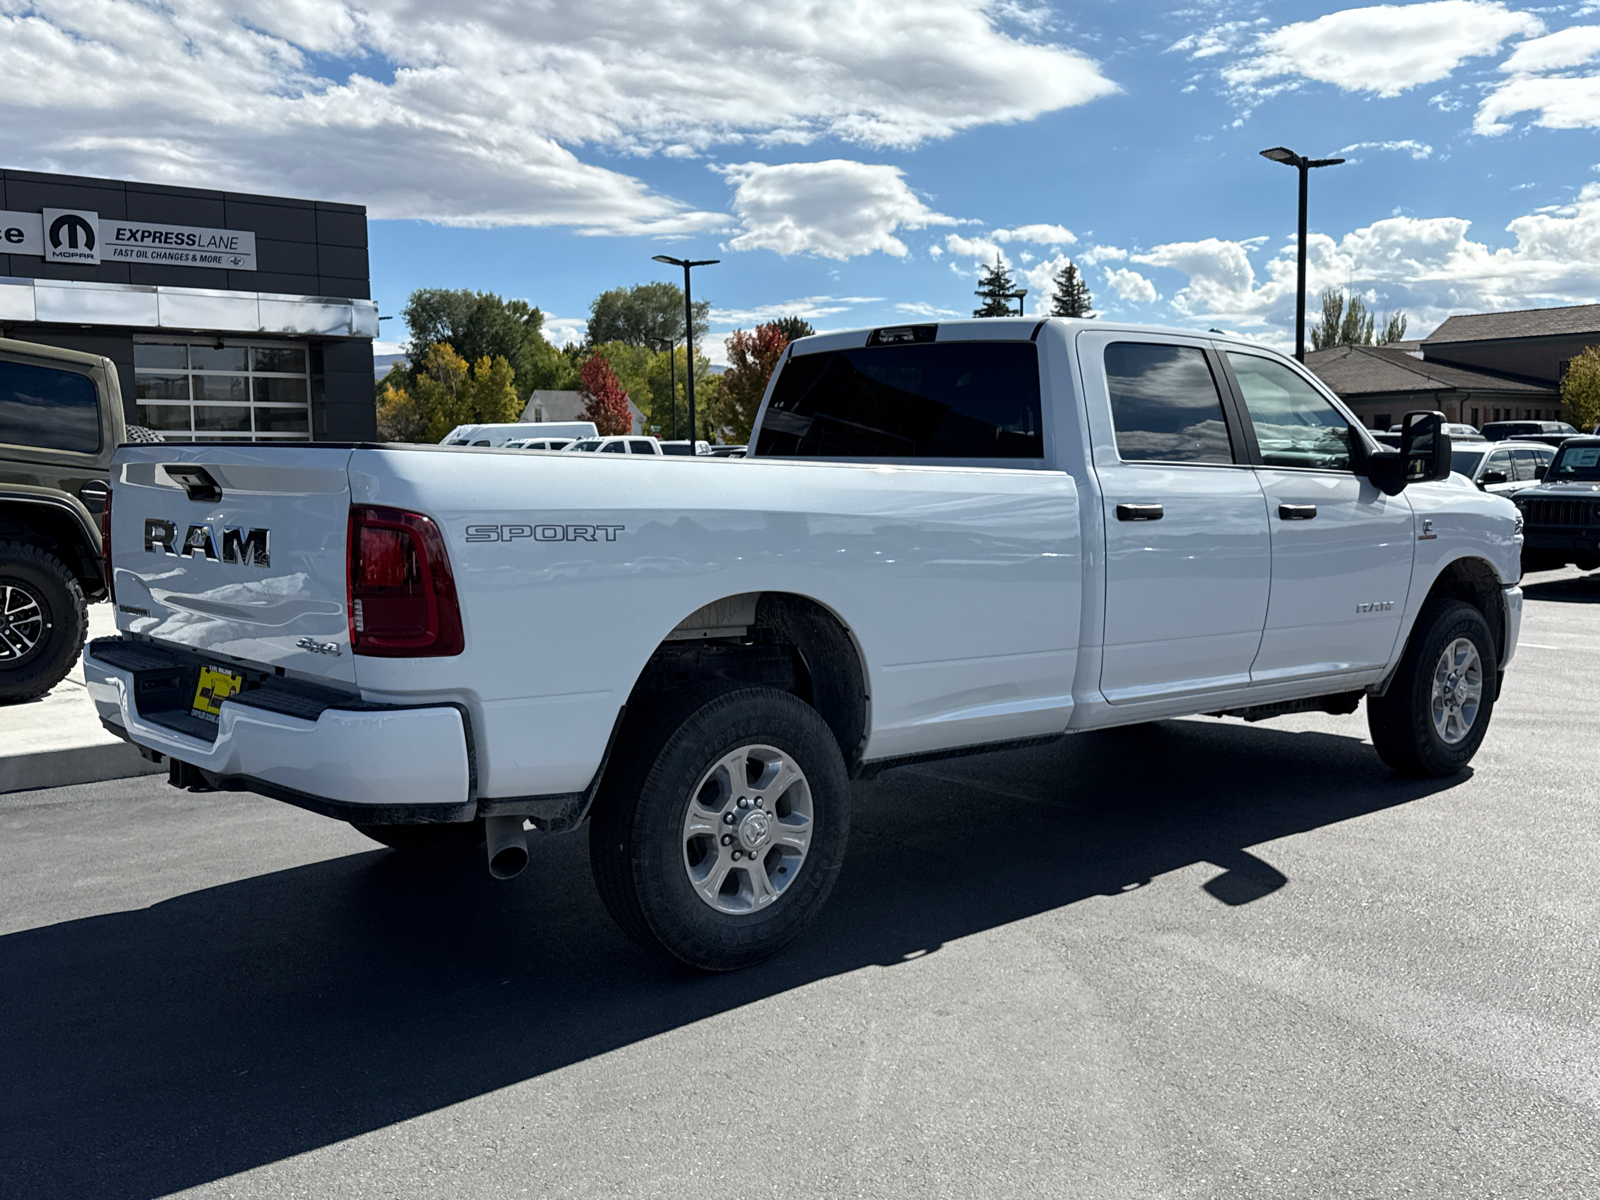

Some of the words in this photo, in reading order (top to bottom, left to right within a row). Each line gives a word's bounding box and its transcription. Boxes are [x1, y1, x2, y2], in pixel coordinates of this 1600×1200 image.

[52, 251, 94, 260] MOPAR
[113, 248, 134, 258] FAST
[136, 250, 149, 259] OIL
[151, 251, 190, 262] CHANGES
[191, 253, 198, 262] &
[199, 254, 223, 264] MORE
[465, 524, 625, 542] SPORT
[144, 518, 271, 568] RAM
[1355, 601, 1395, 614] RAM
